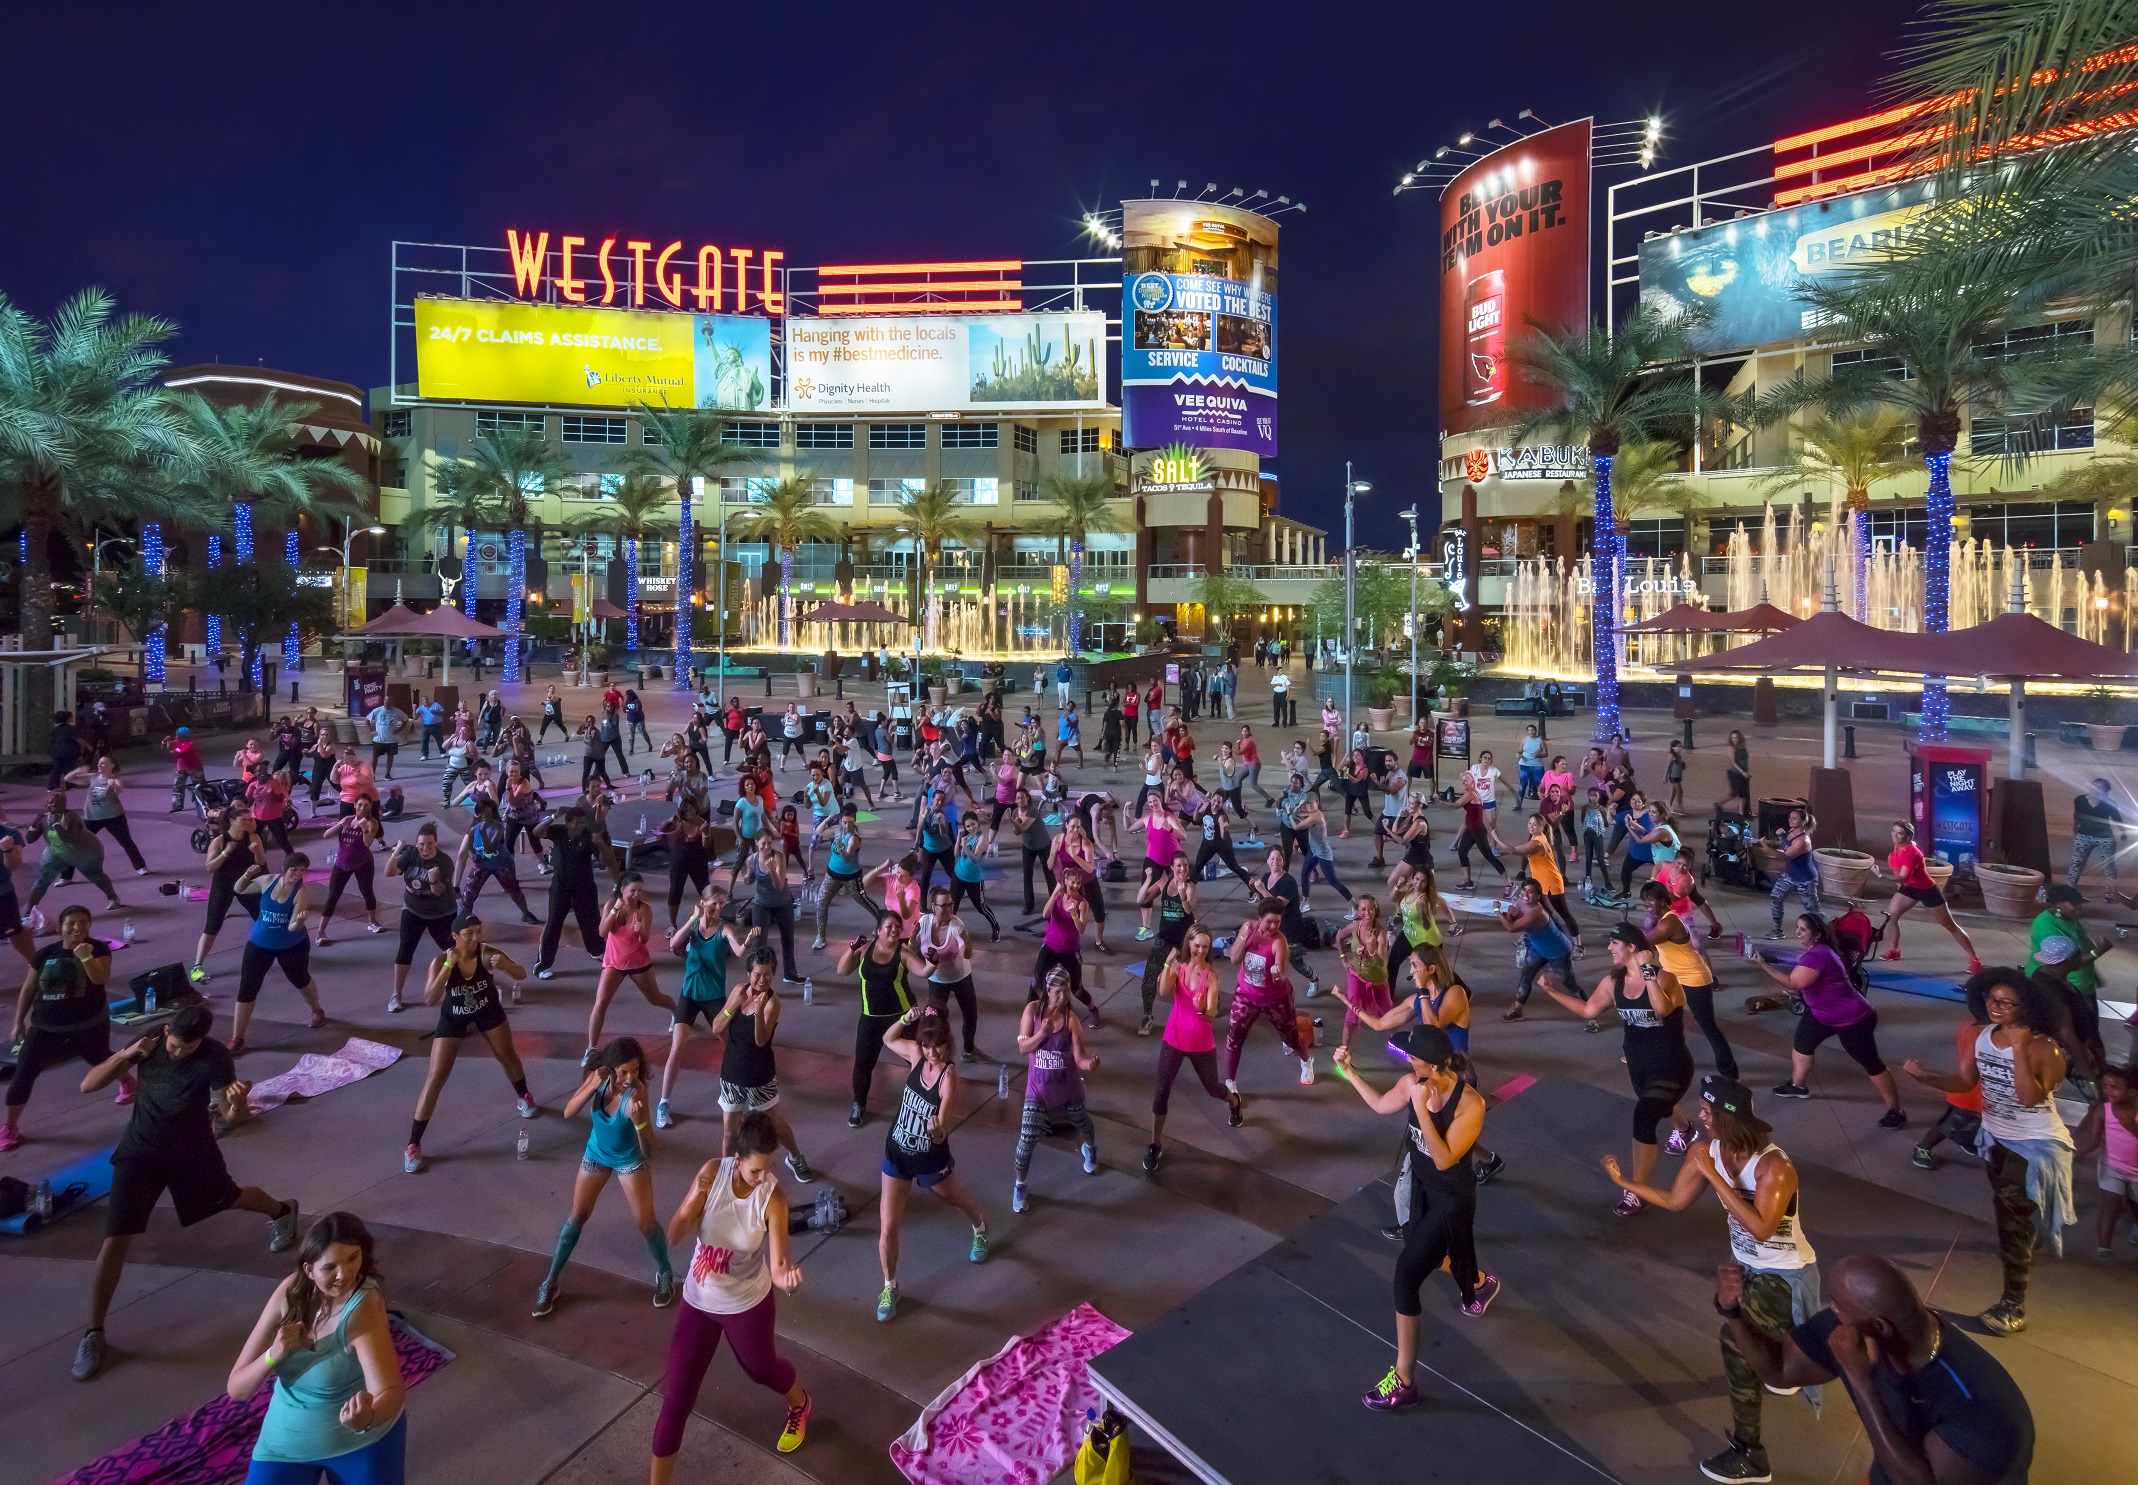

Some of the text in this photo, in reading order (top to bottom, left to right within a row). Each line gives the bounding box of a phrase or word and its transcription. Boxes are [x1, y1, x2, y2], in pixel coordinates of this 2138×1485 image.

[1443, 180, 1563, 251] WITH YOUR
[1442, 204, 1566, 275] TEAM ON IT.
[507, 229, 784, 314] WESTGATE
[1176, 278, 1203, 291] COME
[1206, 281, 1222, 293] SEE
[1224, 283, 1242, 297] WHY
[1257, 289, 1272, 305] WERE
[1176, 291, 1272, 322] VOTED THE BEST
[1472, 299, 1497, 319] BUD
[1468, 310, 1501, 333] LIGHT
[430, 326, 663, 352] 24/7 CLAIMS ASSISTANCE.
[791, 325, 957, 347] Hanging with the locals
[793, 344, 943, 365] is my #bestmedicine.
[1148, 351, 1199, 368] SERVICE
[1221, 355, 1268, 378] COCKTAILS
[604, 373, 685, 387] Liberty Mutual
[818, 382, 891, 396] Dignity Health
[1173, 394, 1248, 411] VEE QUIVA
[1216, 418, 1242, 426] CASINO
[1257, 424, 1272, 441] VQ
[1497, 445, 1591, 467] KABUKI
[1503, 470, 1543, 479] JAPANESE
[1142, 484, 1168, 492] TACOS
[1176, 482, 1213, 491] TEQUILA
[1454, 529, 1468, 537] Bar
[637, 577, 677, 585] WHISKEY
[646, 584, 668, 592] ROSE
[1947, 769, 1966, 777] PLAY
[1949, 778, 1975, 788] NIGHT
[1936, 820, 1973, 833] WESTGATE
[451, 980, 487, 997] MUSCLES
[452, 996, 489, 1015] MASCARA
[1048, 1059, 1064, 1068] SAID
[903, 1086, 935, 1119] STRAIGHT
[900, 1103, 931, 1138] OUTT
[892, 1124, 930, 1152] ARIZONA
